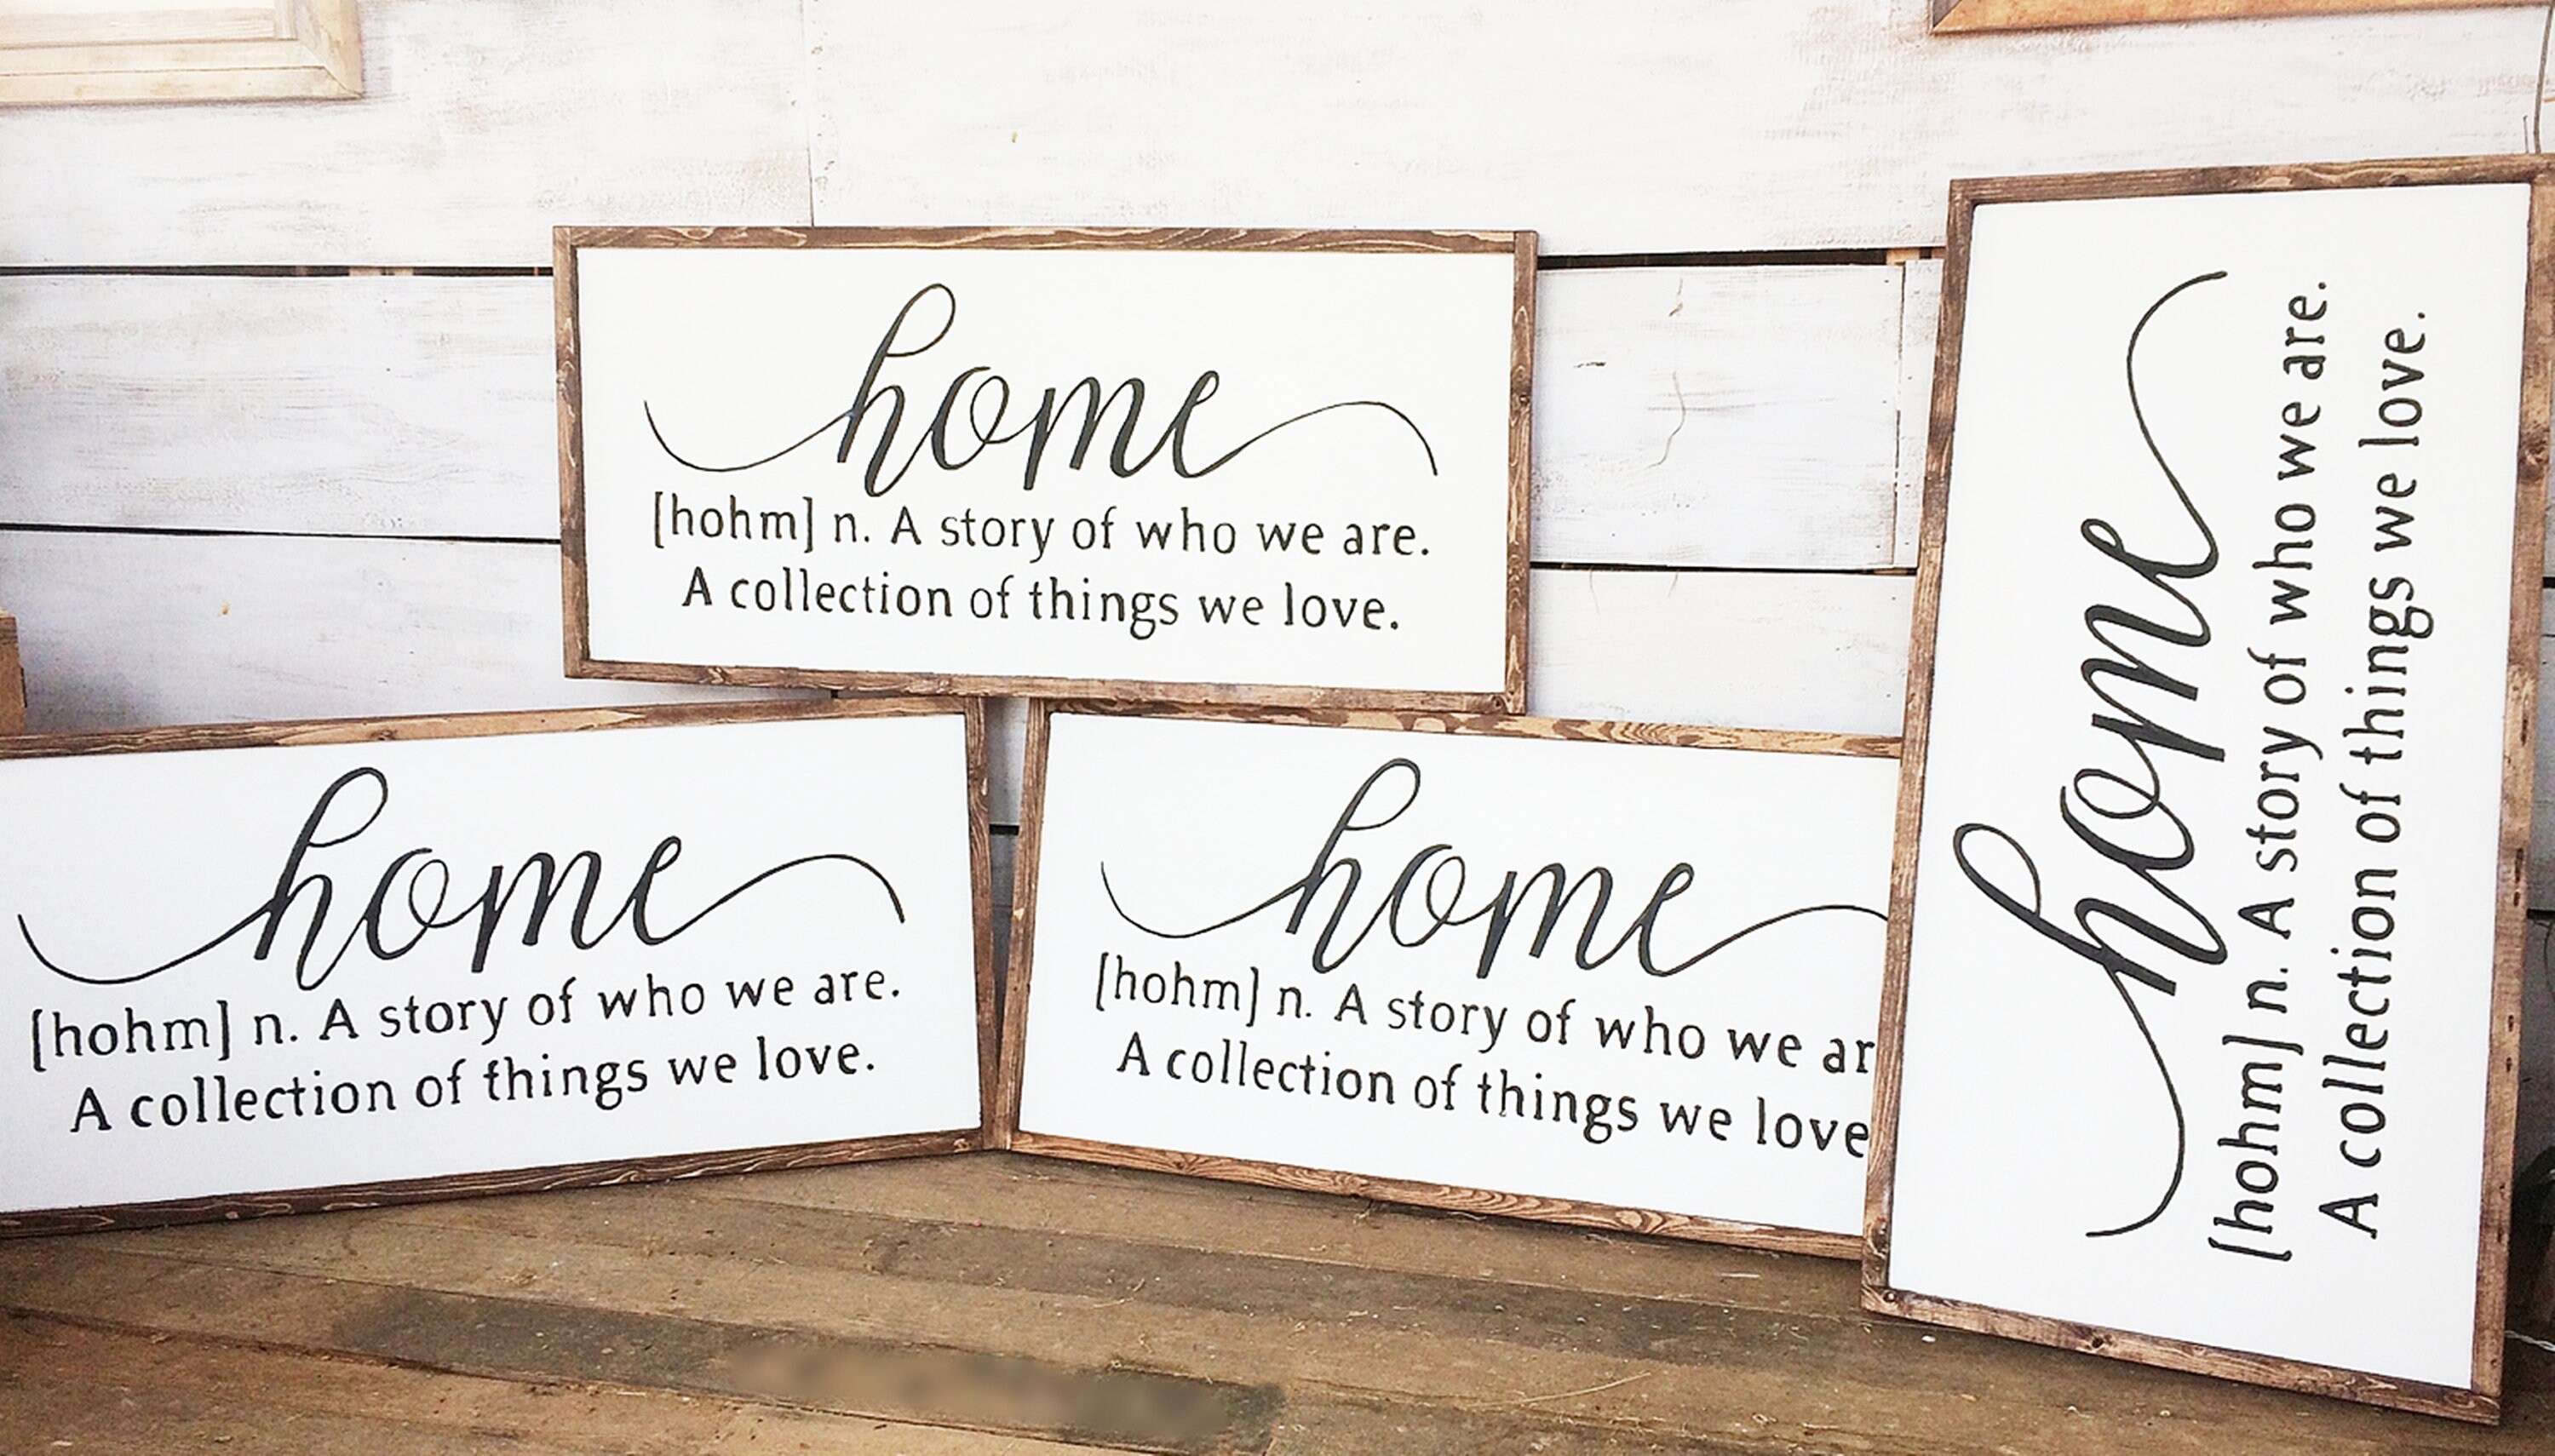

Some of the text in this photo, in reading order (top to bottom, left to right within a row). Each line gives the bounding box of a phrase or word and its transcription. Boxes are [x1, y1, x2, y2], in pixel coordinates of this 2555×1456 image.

[644, 283, 1438, 498] home
[654, 490, 1432, 564] [hohm] n. A story of who we are.
[681, 565, 1398, 640] A collection of things we love.
[1952, 271, 2228, 1238] home
[2208, 282, 2328, 1262] [hohm] n. A story of who we are.
[2318, 311, 2434, 1240] A collection of things we love.
[17, 766, 905, 991] home
[1100, 757, 1890, 977] home
[32, 970, 899, 1073] [hohm] n. A story of who we are.
[70, 1035, 875, 1133] A collection of things we love.
[1095, 951, 1876, 1074] [hohm] n. A story of who we ar
[1116, 1031, 1869, 1159] A collection of things we love
